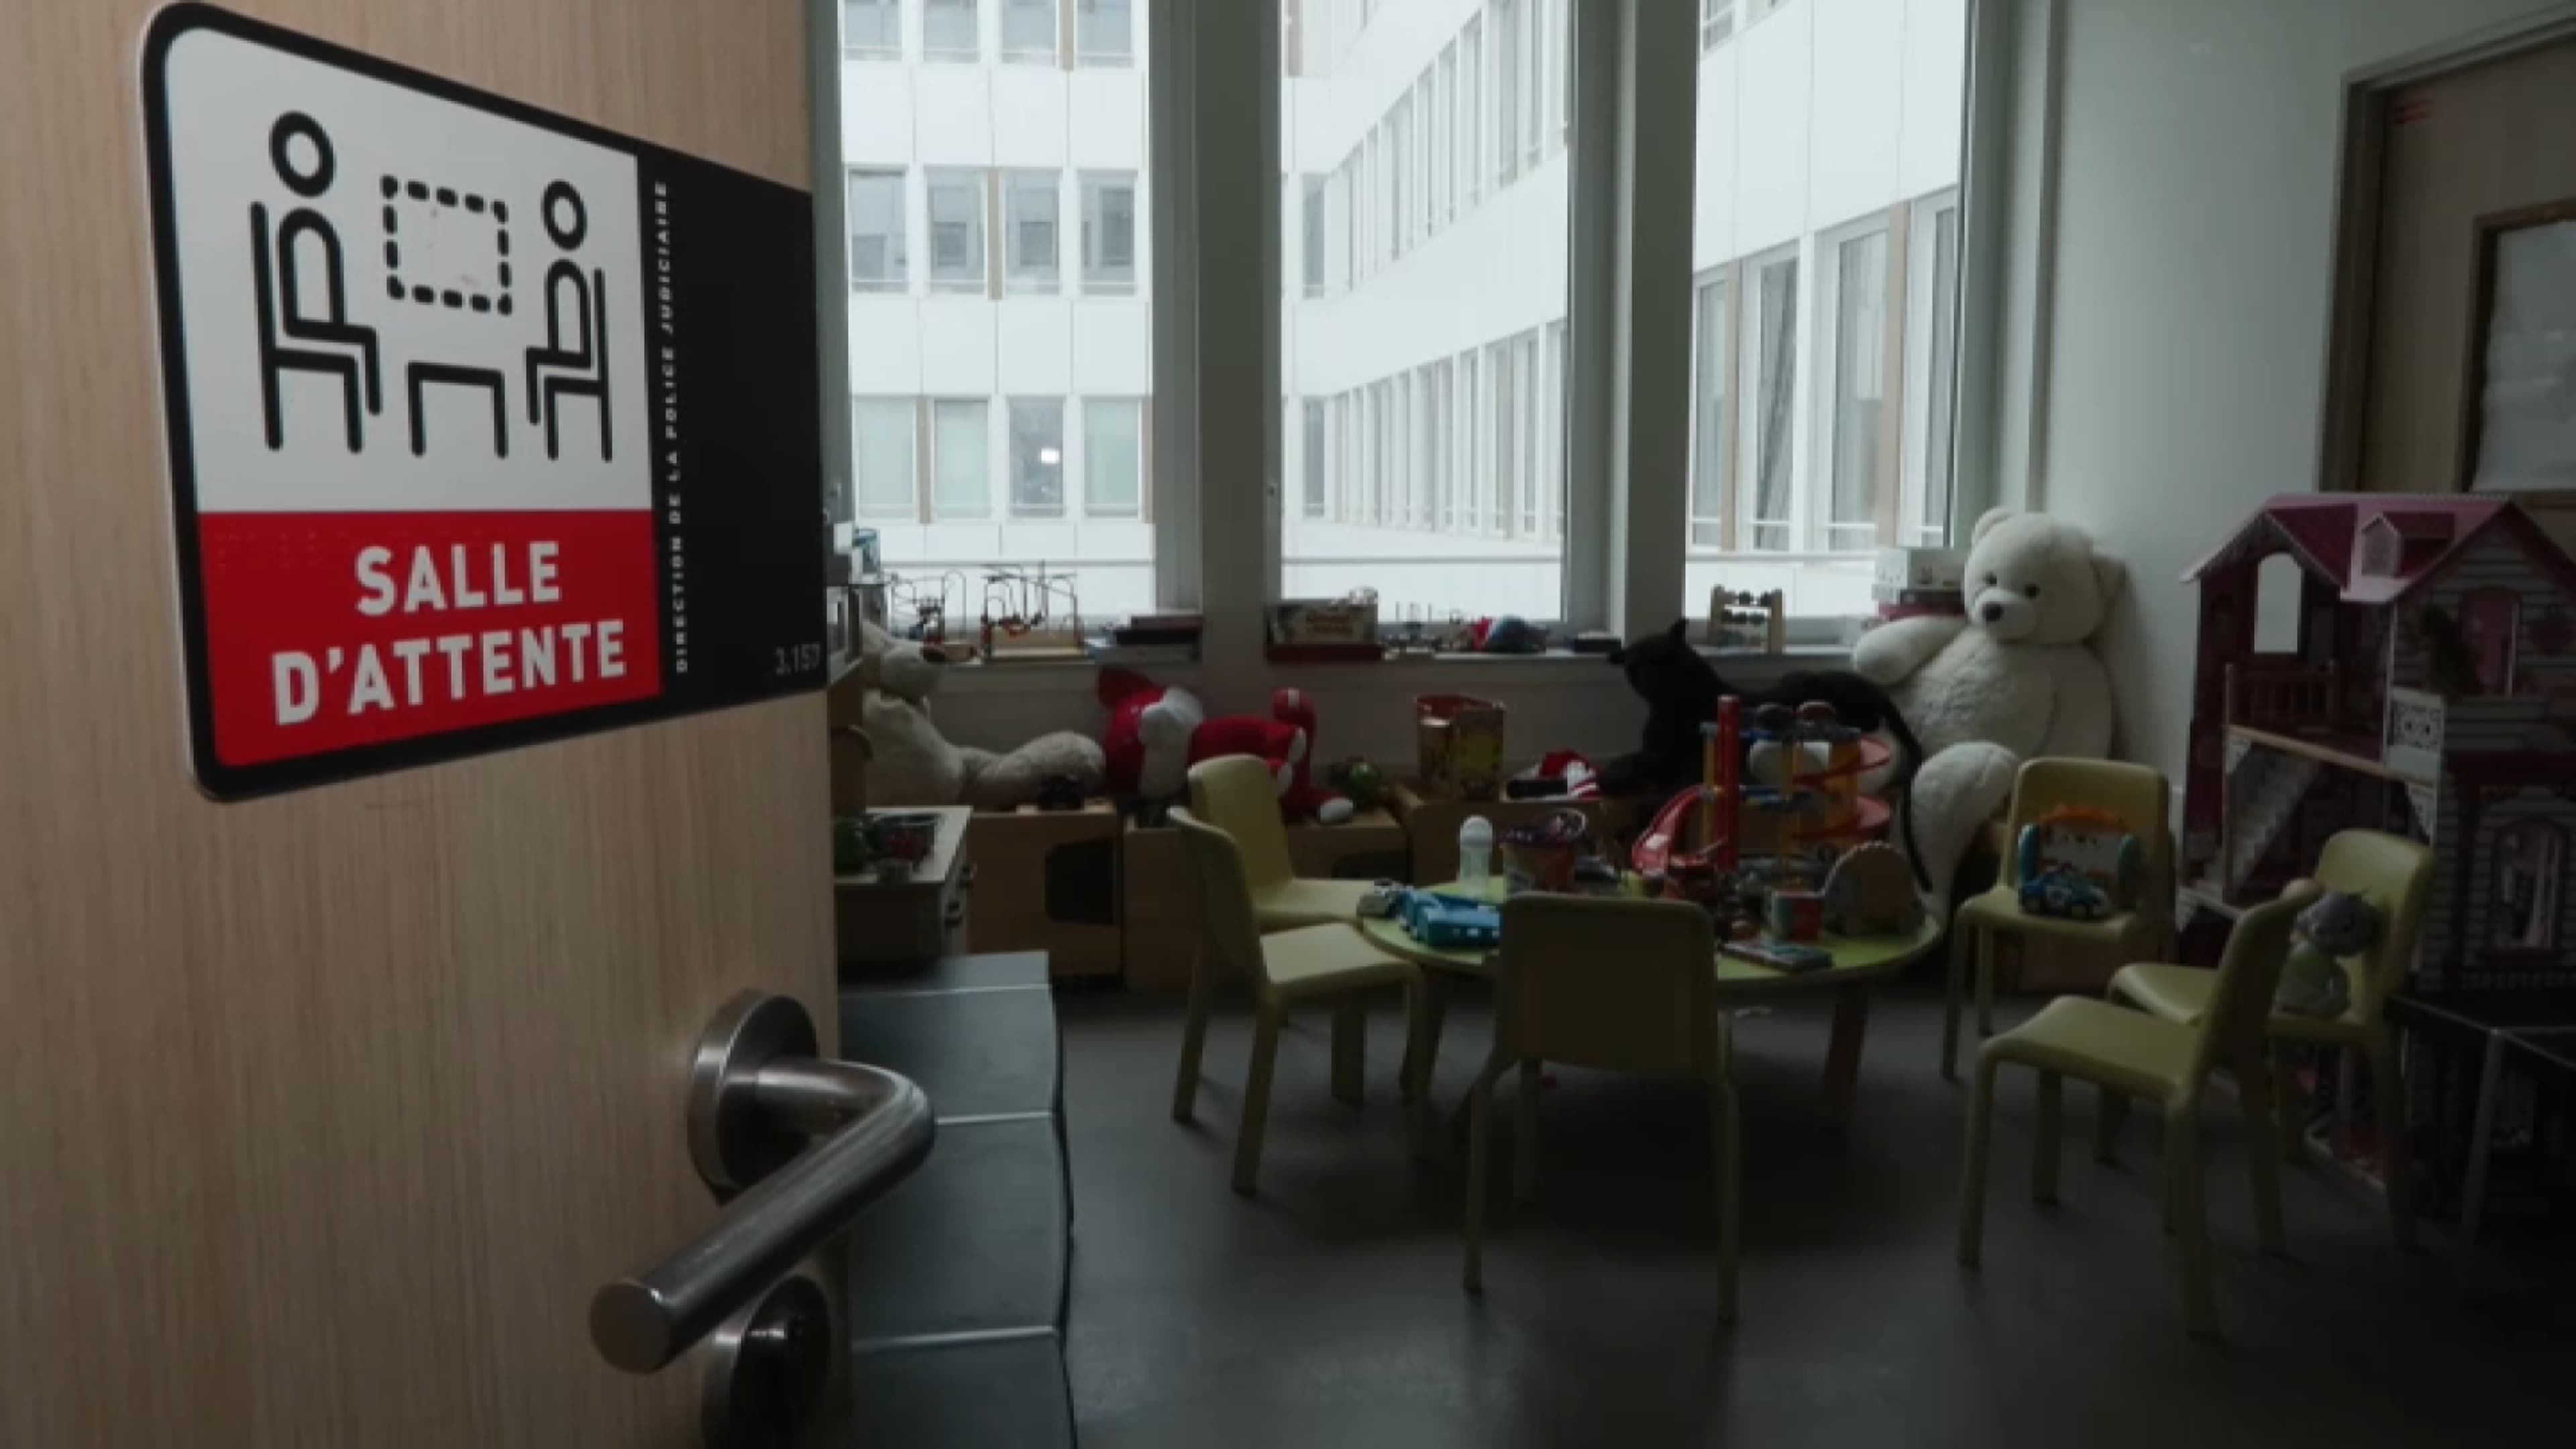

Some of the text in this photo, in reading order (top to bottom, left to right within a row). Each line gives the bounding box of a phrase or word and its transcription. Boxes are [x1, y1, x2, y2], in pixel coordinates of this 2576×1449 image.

[653, 180, 688, 673] DIRECTION DE LA POLICE JUDICIAIRE
[356, 541, 561, 616] SALLE
[271, 619, 628, 726] D'ATTENTE
